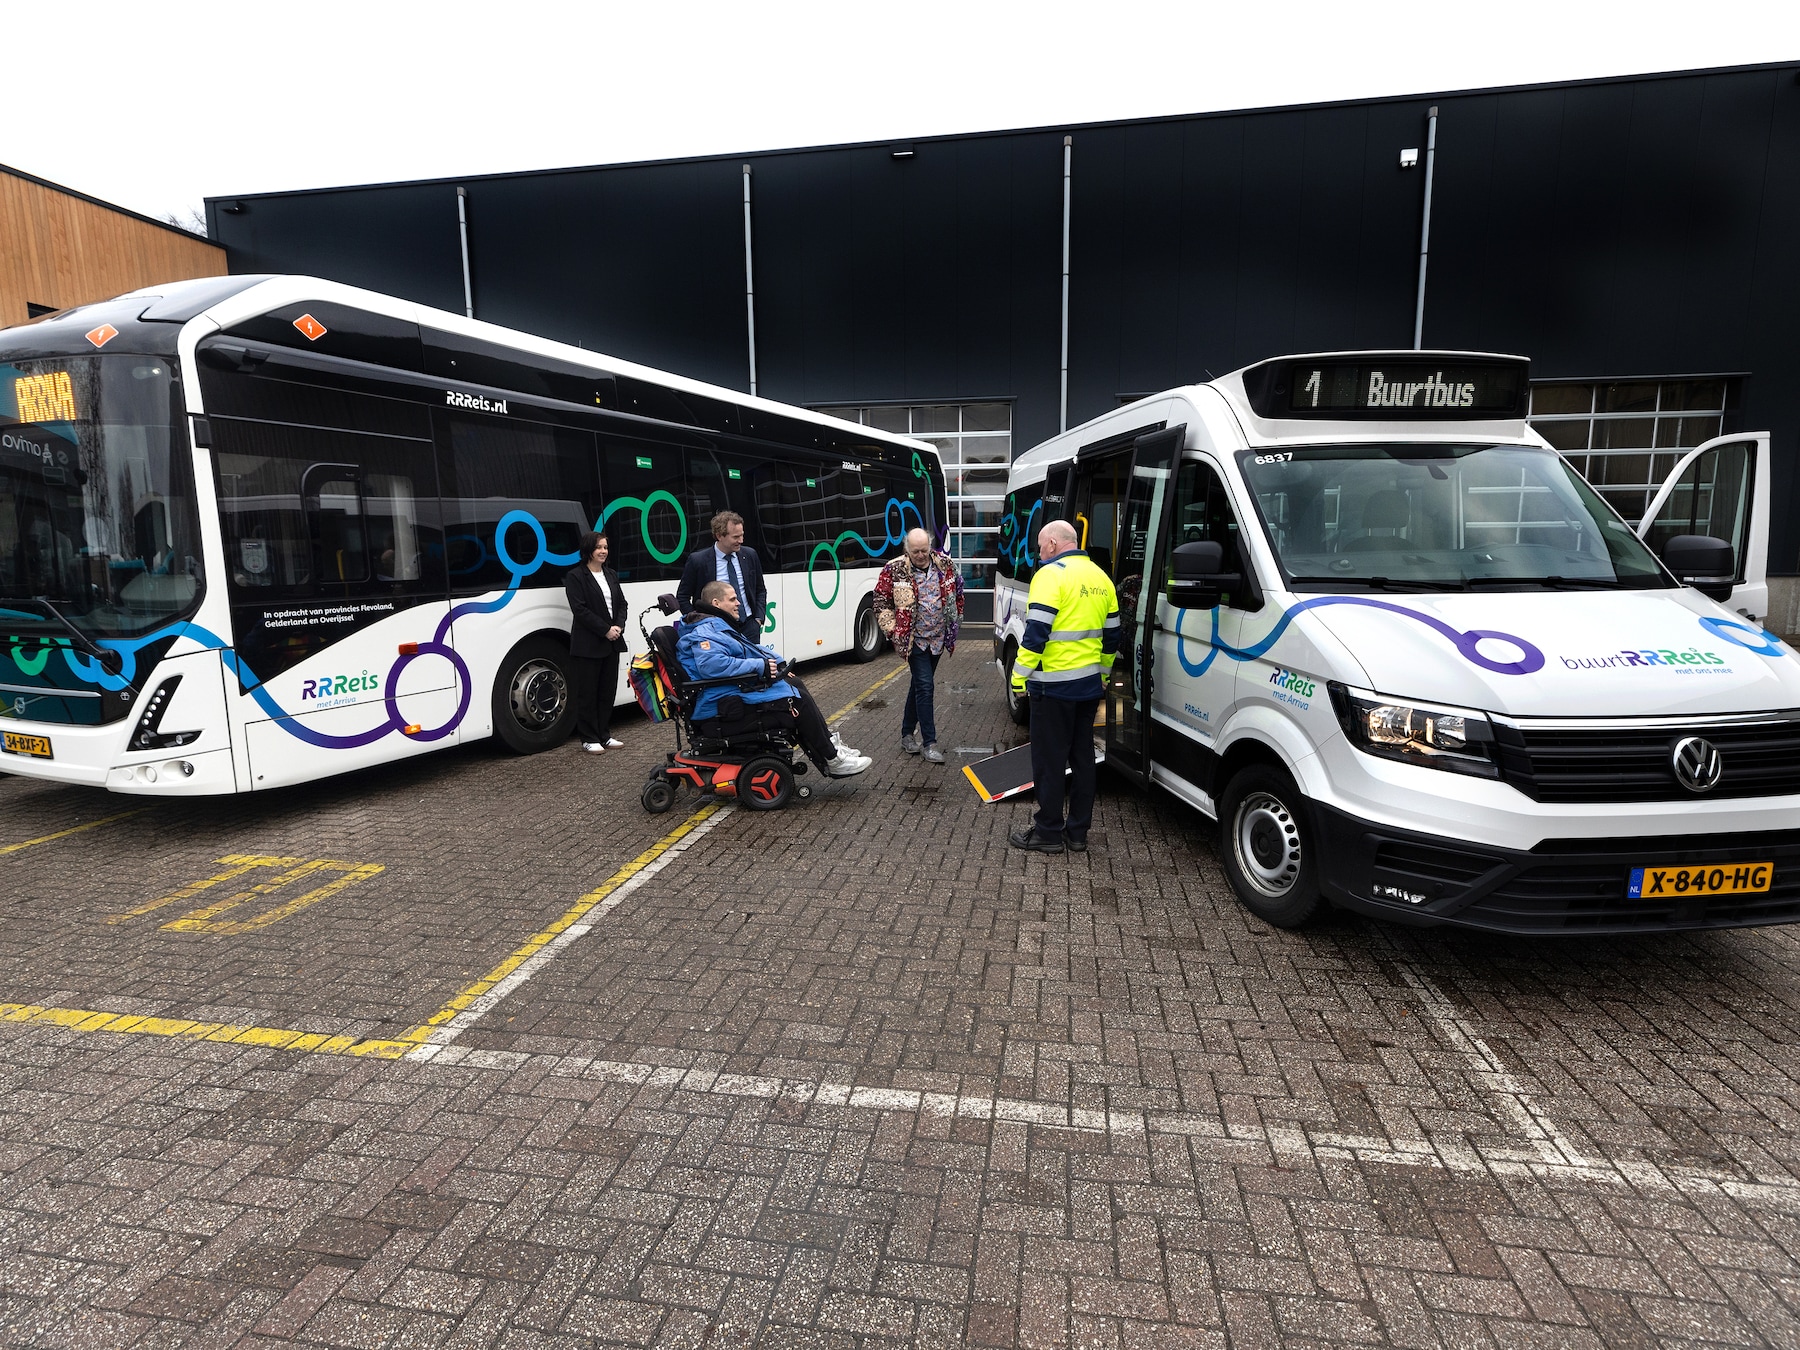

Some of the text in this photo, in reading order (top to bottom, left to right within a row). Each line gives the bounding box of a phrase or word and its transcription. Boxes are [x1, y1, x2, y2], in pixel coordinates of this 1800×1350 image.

[15, 371, 76, 423] ARRIVA
[1304, 371, 1475, 407] 1 Buurtbus
[446, 390, 508, 414] RRReis.nl
[1254, 452, 1293, 465] 6837
[263, 602, 395, 620] In opdracht van provincies Flevoland,
[264, 613, 355, 628] Gelderland en Overijssel
[1674, 667, 1734, 675] met ons mee
[302, 669, 379, 700] RRReis
[1269, 666, 1316, 698] RRReis
[316, 696, 357, 709] met Arriva
[1272, 690, 1309, 711] met Arriva
[6, 734, 47, 753] 34-BXF-2
[1629, 885, 1640, 894] NL
[1649, 865, 1768, 894] X-840-HG
